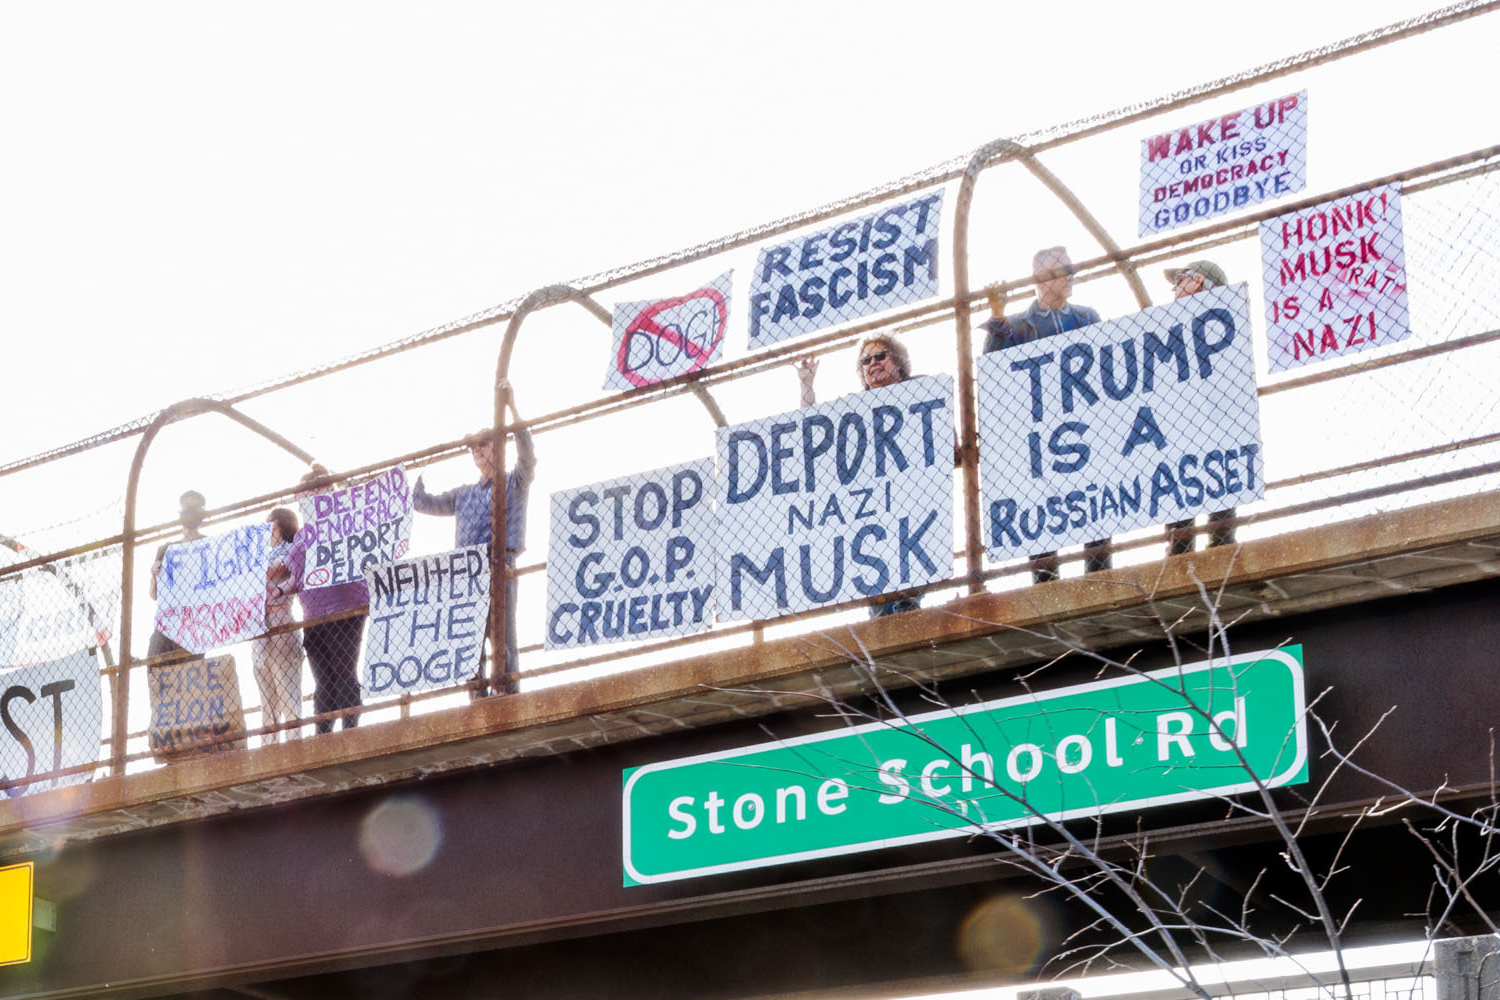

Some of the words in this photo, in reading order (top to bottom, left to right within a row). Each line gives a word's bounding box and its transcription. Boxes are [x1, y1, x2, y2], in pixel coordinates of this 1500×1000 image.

[1148, 112, 1242, 163] WAKE
[1254, 96, 1299, 129] UP
[1180, 153, 1207, 174] OR
[1216, 136, 1267, 164] KISS
[1154, 149, 1288, 203] DEMOCRACY
[1154, 171, 1291, 228] GOODBYE
[762, 196, 941, 285] RESIST
[1282, 192, 1387, 249] HONK!
[1279, 232, 1381, 286] MUSK
[750, 237, 939, 339] FASCISM
[1273, 296, 1300, 324] IS
[1318, 287, 1334, 313] A
[1293, 311, 1377, 361] NAZI
[1011, 307, 1236, 423] TRUMP
[726, 397, 946, 505] DEPORT
[1027, 421, 1090, 479] IS
[1121, 406, 1168, 457] A
[314, 467, 405, 519] DEFEND
[567, 468, 702, 550] STOP
[787, 481, 891, 535] NAZI
[1148, 443, 1259, 518] ASSET
[165, 523, 272, 592] FIGHT
[315, 516, 405, 567] DEPORT
[575, 535, 697, 599] G.O.P.
[730, 508, 940, 612] MUSK
[374, 601, 477, 654] THE
[548, 583, 714, 645] CRUELTY
[157, 661, 223, 698] FIRE
[368, 644, 477, 692] DOGE
[156, 694, 224, 727] ELON
[667, 777, 849, 841] Stone
[878, 717, 1124, 805] School
[1156, 696, 1248, 762] Rd
